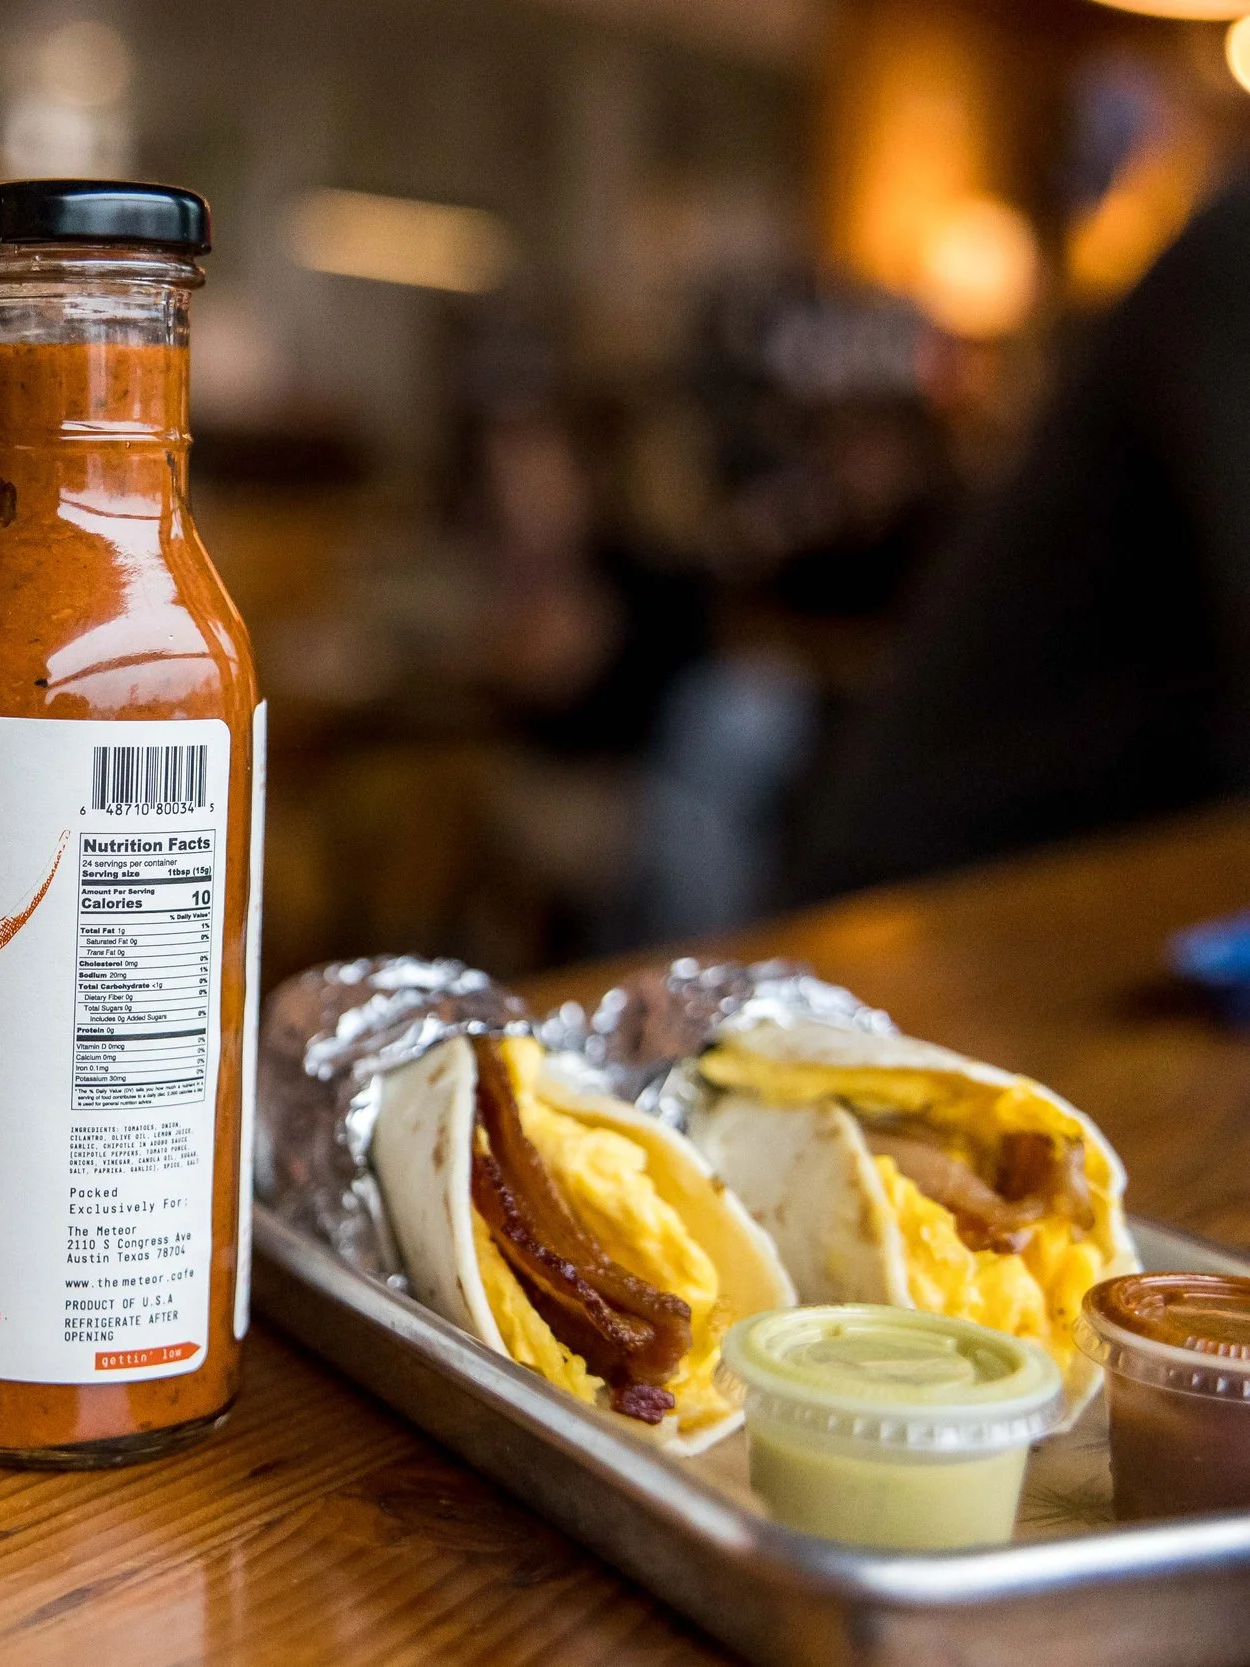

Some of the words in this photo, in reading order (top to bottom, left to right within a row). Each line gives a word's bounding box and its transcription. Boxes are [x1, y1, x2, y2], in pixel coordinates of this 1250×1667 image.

[106, 803, 149, 816] 48710
[156, 802, 194, 815] 80034
[84, 839, 163, 853] Nutrition
[168, 836, 210, 851] Facts
[82, 859, 93, 867] 24
[94, 860, 128, 869] servings
[129, 861, 142, 869] per
[143, 858, 177, 867] container
[82, 870, 119, 879] Serving
[168, 868, 190, 877] 1tbsp
[192, 866, 212, 876] (15g)
[81, 897, 142, 909] Calories
[192, 890, 211, 906] 10
[109, 972, 127, 980] 20mg
[70, 1187, 118, 1198] Packed
[69, 1201, 155, 1214] Exclusively
[68, 1226, 88, 1237] The
[96, 1226, 137, 1236] Meteor
[67, 1239, 95, 1250] 2110
[103, 1239, 110, 1250] S
[117, 1236, 169, 1250] Congress
[175, 1232, 191, 1242] Ave
[67, 1253, 109, 1264] Austin
[118, 1252, 149, 1262] Texas
[157, 1245, 185, 1258] 78704
[65, 1299, 114, 1311] PRODUCT
[122, 1298, 135, 1309] OF
[142, 1293, 173, 1307] U.S.A
[64, 1315, 141, 1329] REFRIGERATE
[148, 1310, 178, 1324] AFTER
[64, 1331, 114, 1342] OPENING
[164, 1349, 181, 1359] low
